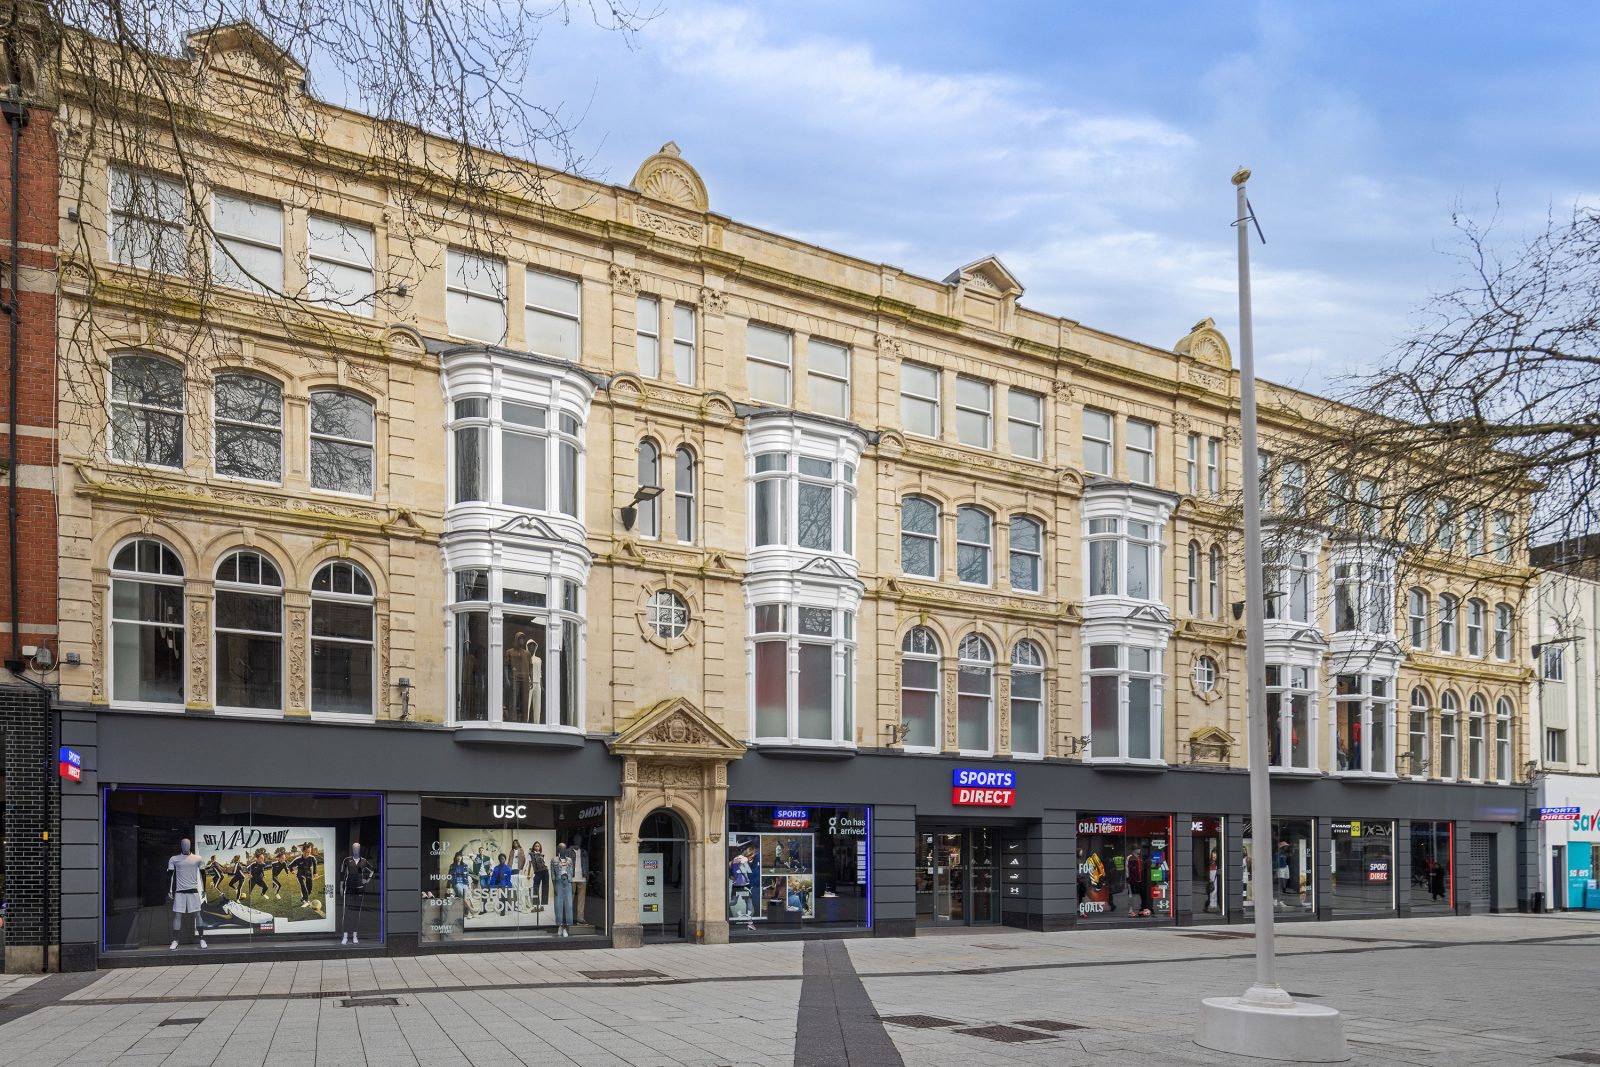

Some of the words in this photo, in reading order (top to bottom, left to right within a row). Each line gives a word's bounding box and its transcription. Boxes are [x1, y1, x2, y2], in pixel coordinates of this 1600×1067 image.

[960, 771, 1012, 786] SPORTS
[960, 789, 1011, 804] DIRECT
[493, 805, 527, 818] USC
[777, 810, 806, 818] SPORTS
[777, 819, 806, 827] DIRECT
[840, 818, 850, 826] On
[852, 818, 866, 826] has
[840, 827, 867, 835] arrived.
[203, 834, 217, 846] GET
[215, 827, 261, 851] MAD
[262, 829, 289, 845] READY
[1078, 863, 1092, 874] FOR
[1079, 901, 1104, 913] GOALS
